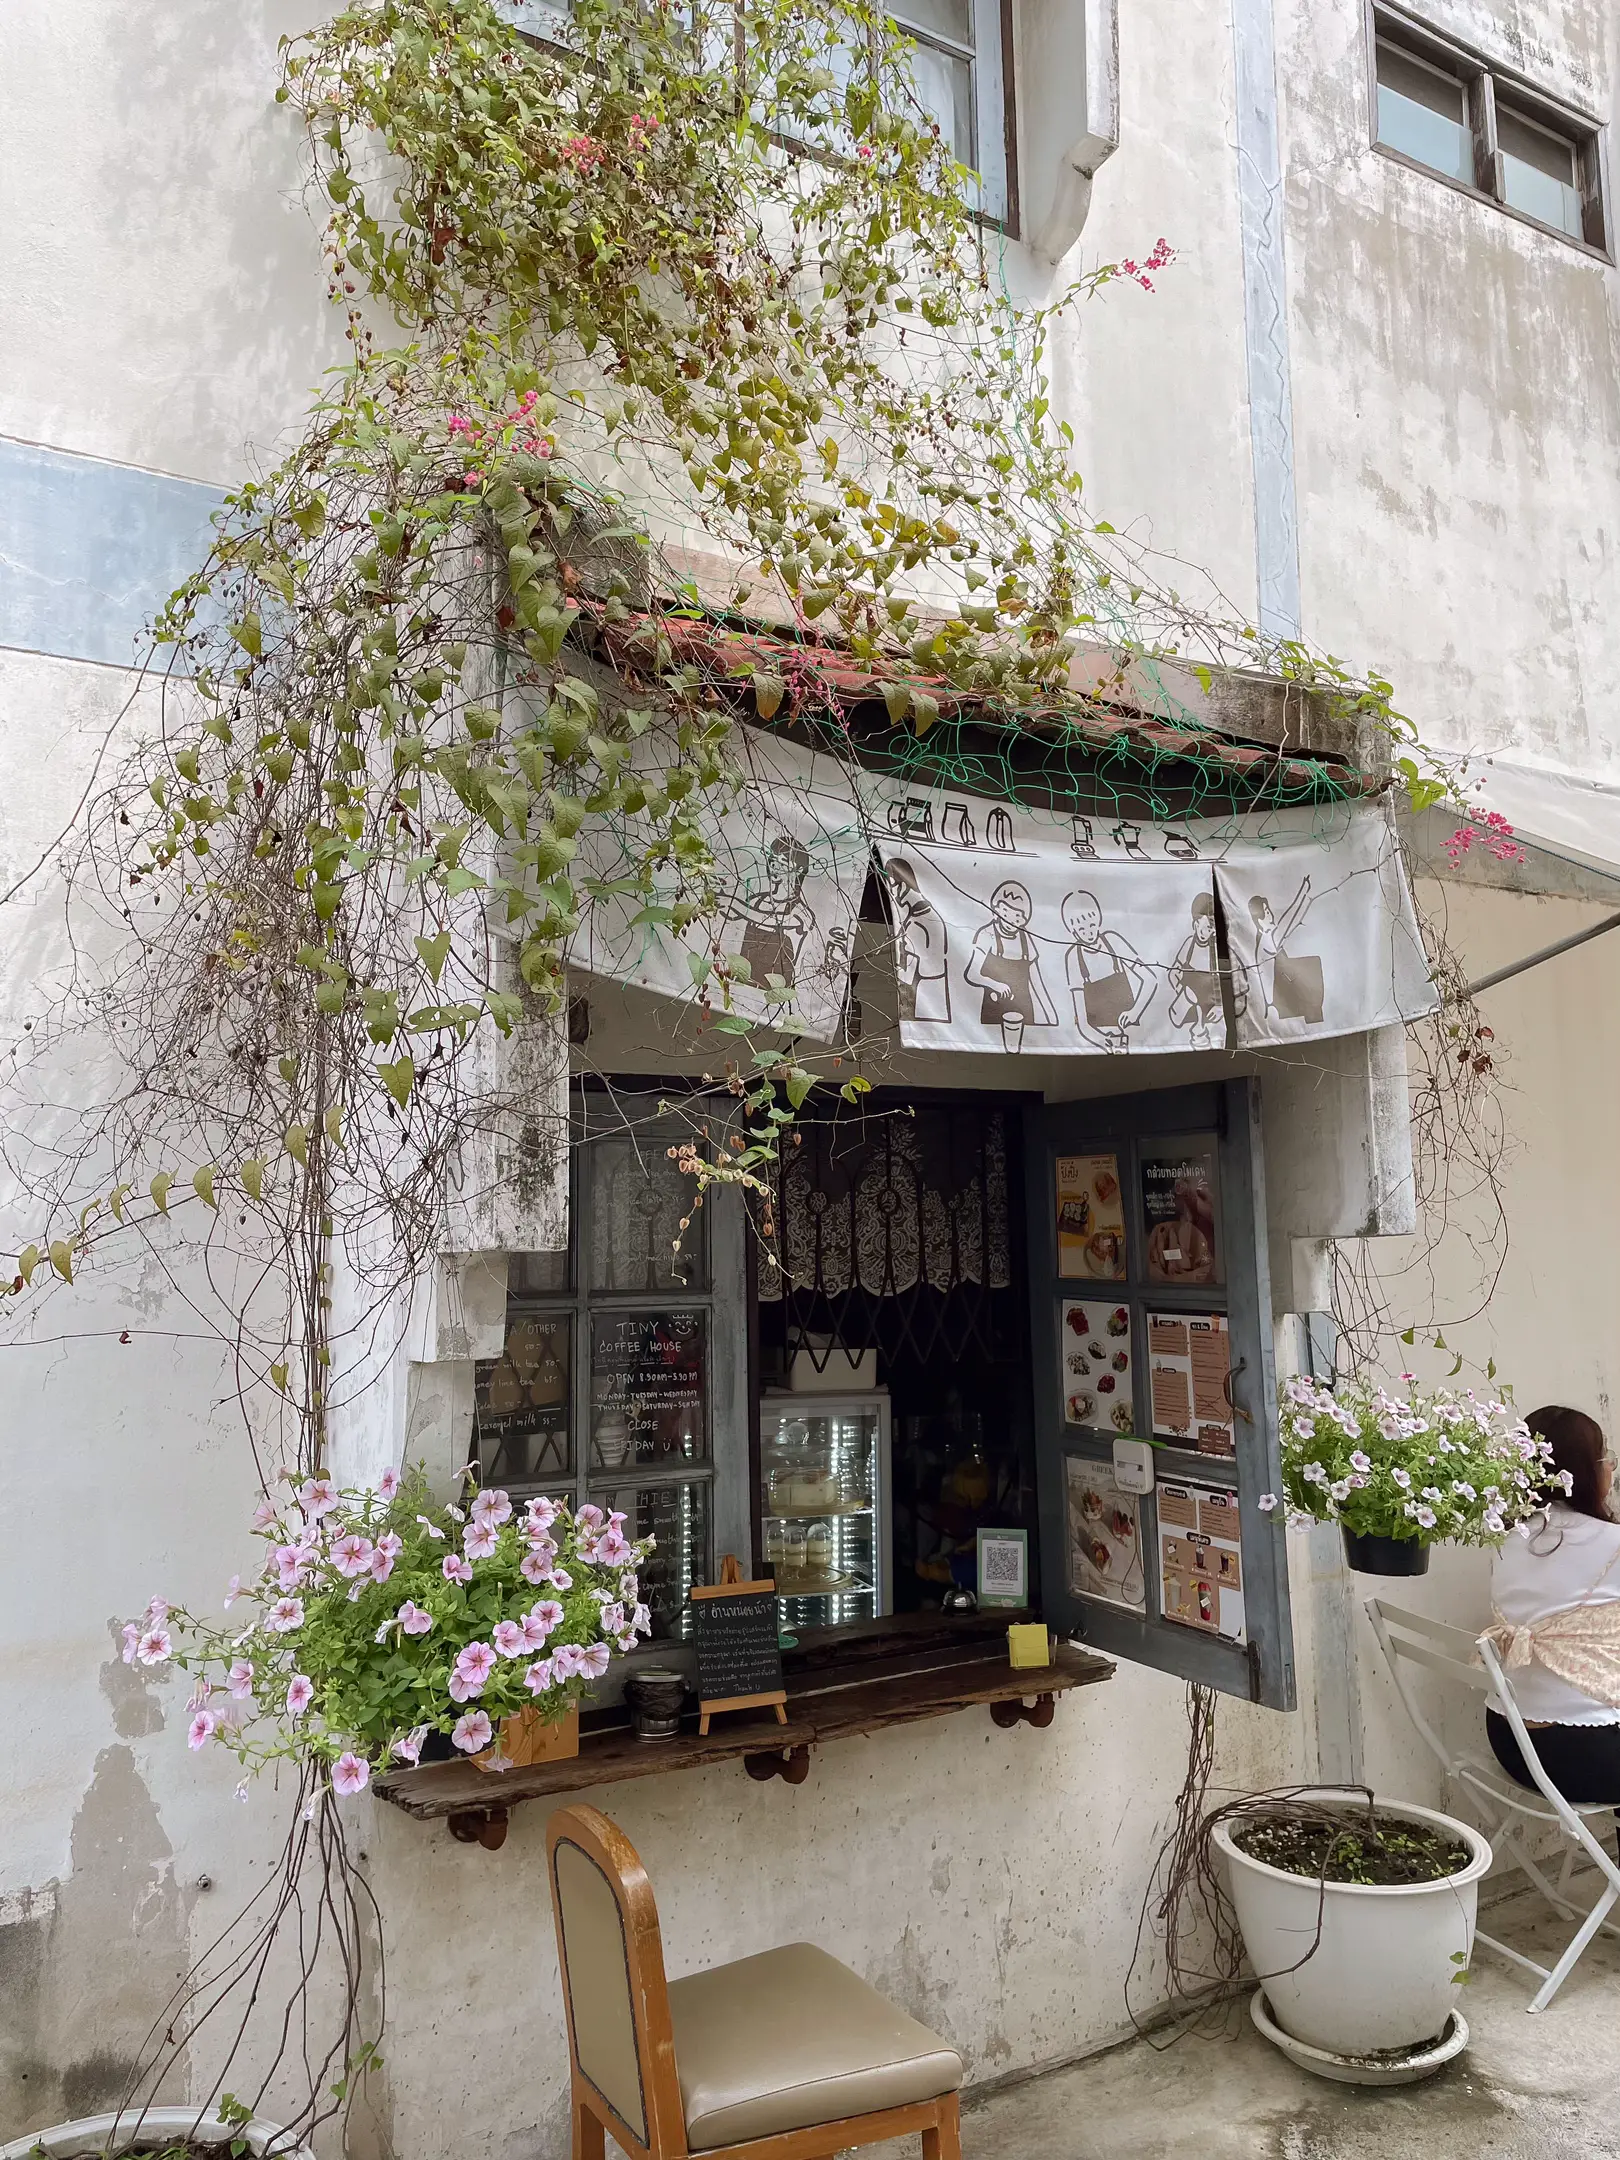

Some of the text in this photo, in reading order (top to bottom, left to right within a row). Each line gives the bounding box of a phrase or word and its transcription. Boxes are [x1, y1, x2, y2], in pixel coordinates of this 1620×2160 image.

[615, 1320, 659, 1336] TINY
[599, 1339, 682, 1354] COFFEE HOUSE
[606, 1372, 636, 1385] OPEN
[516, 1413, 536, 1427] milk
[627, 1420, 659, 1431] CLOSE
[613, 1439, 655, 1451] FRIDAY
